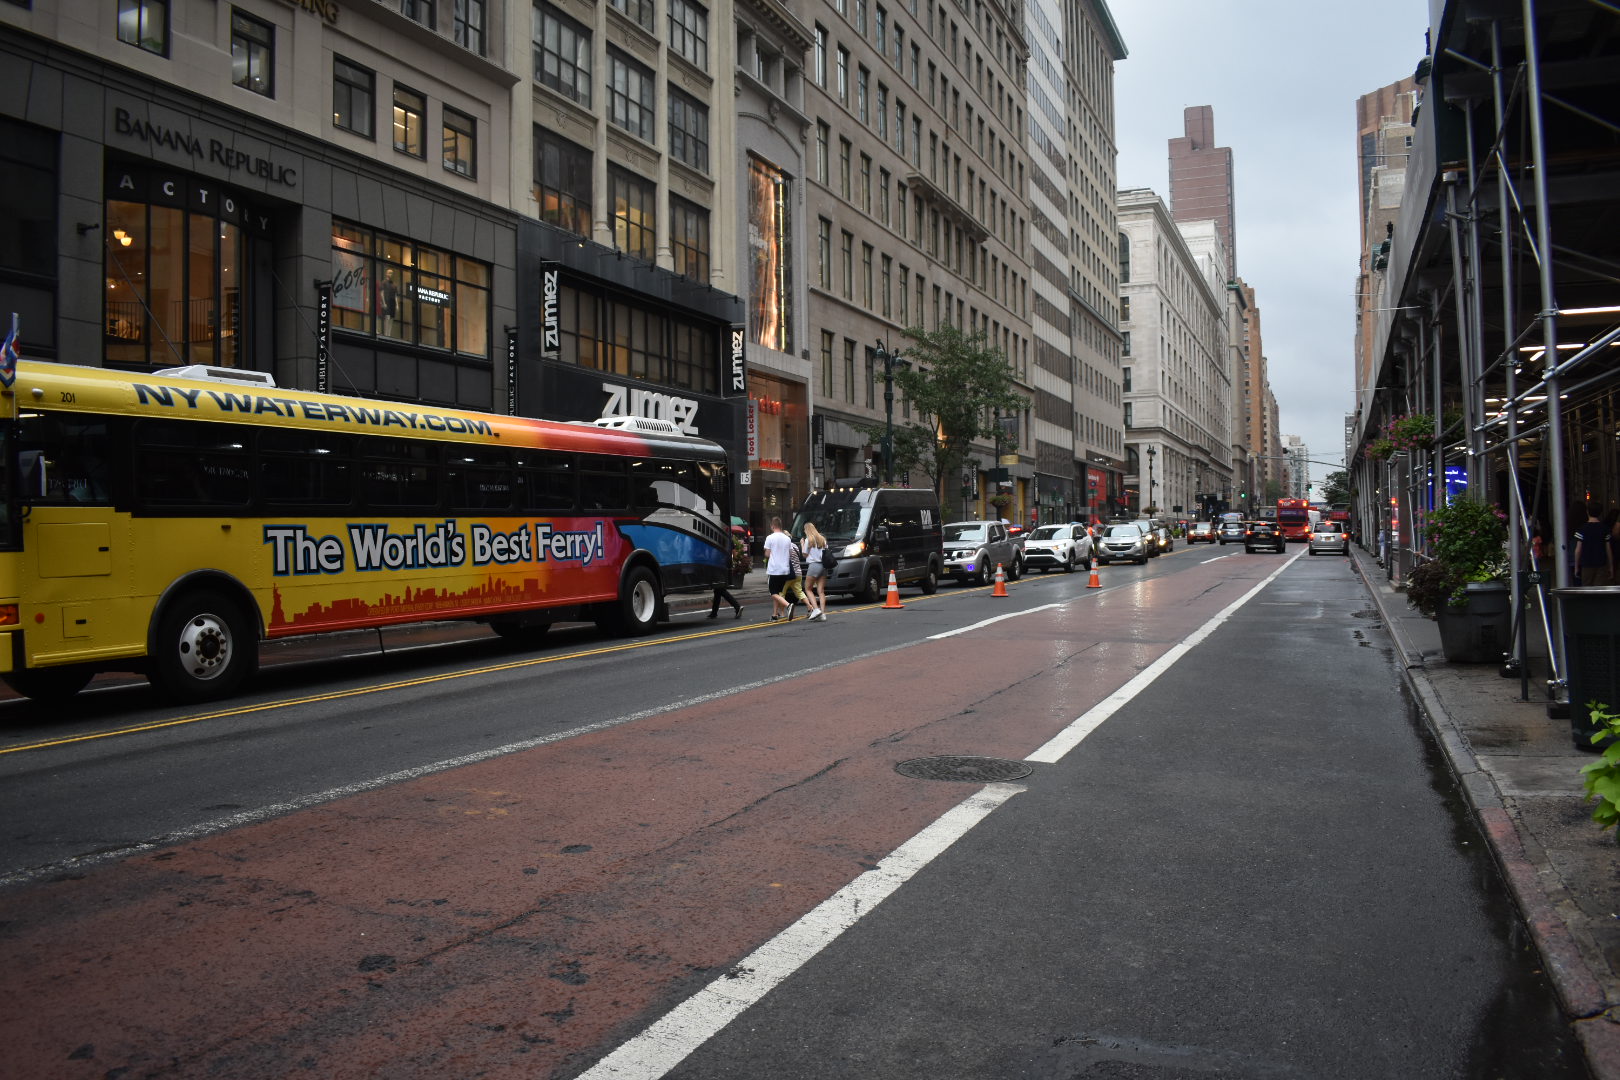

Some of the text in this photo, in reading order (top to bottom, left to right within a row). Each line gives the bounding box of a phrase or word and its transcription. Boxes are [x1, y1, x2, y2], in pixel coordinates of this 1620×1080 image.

[115, 107, 297, 188] BANANA REPUBLIC
[332, 266, 367, 298] 60%
[60, 391, 76, 404] 201
[264, 519, 604, 576] The World's Best Ferry!
